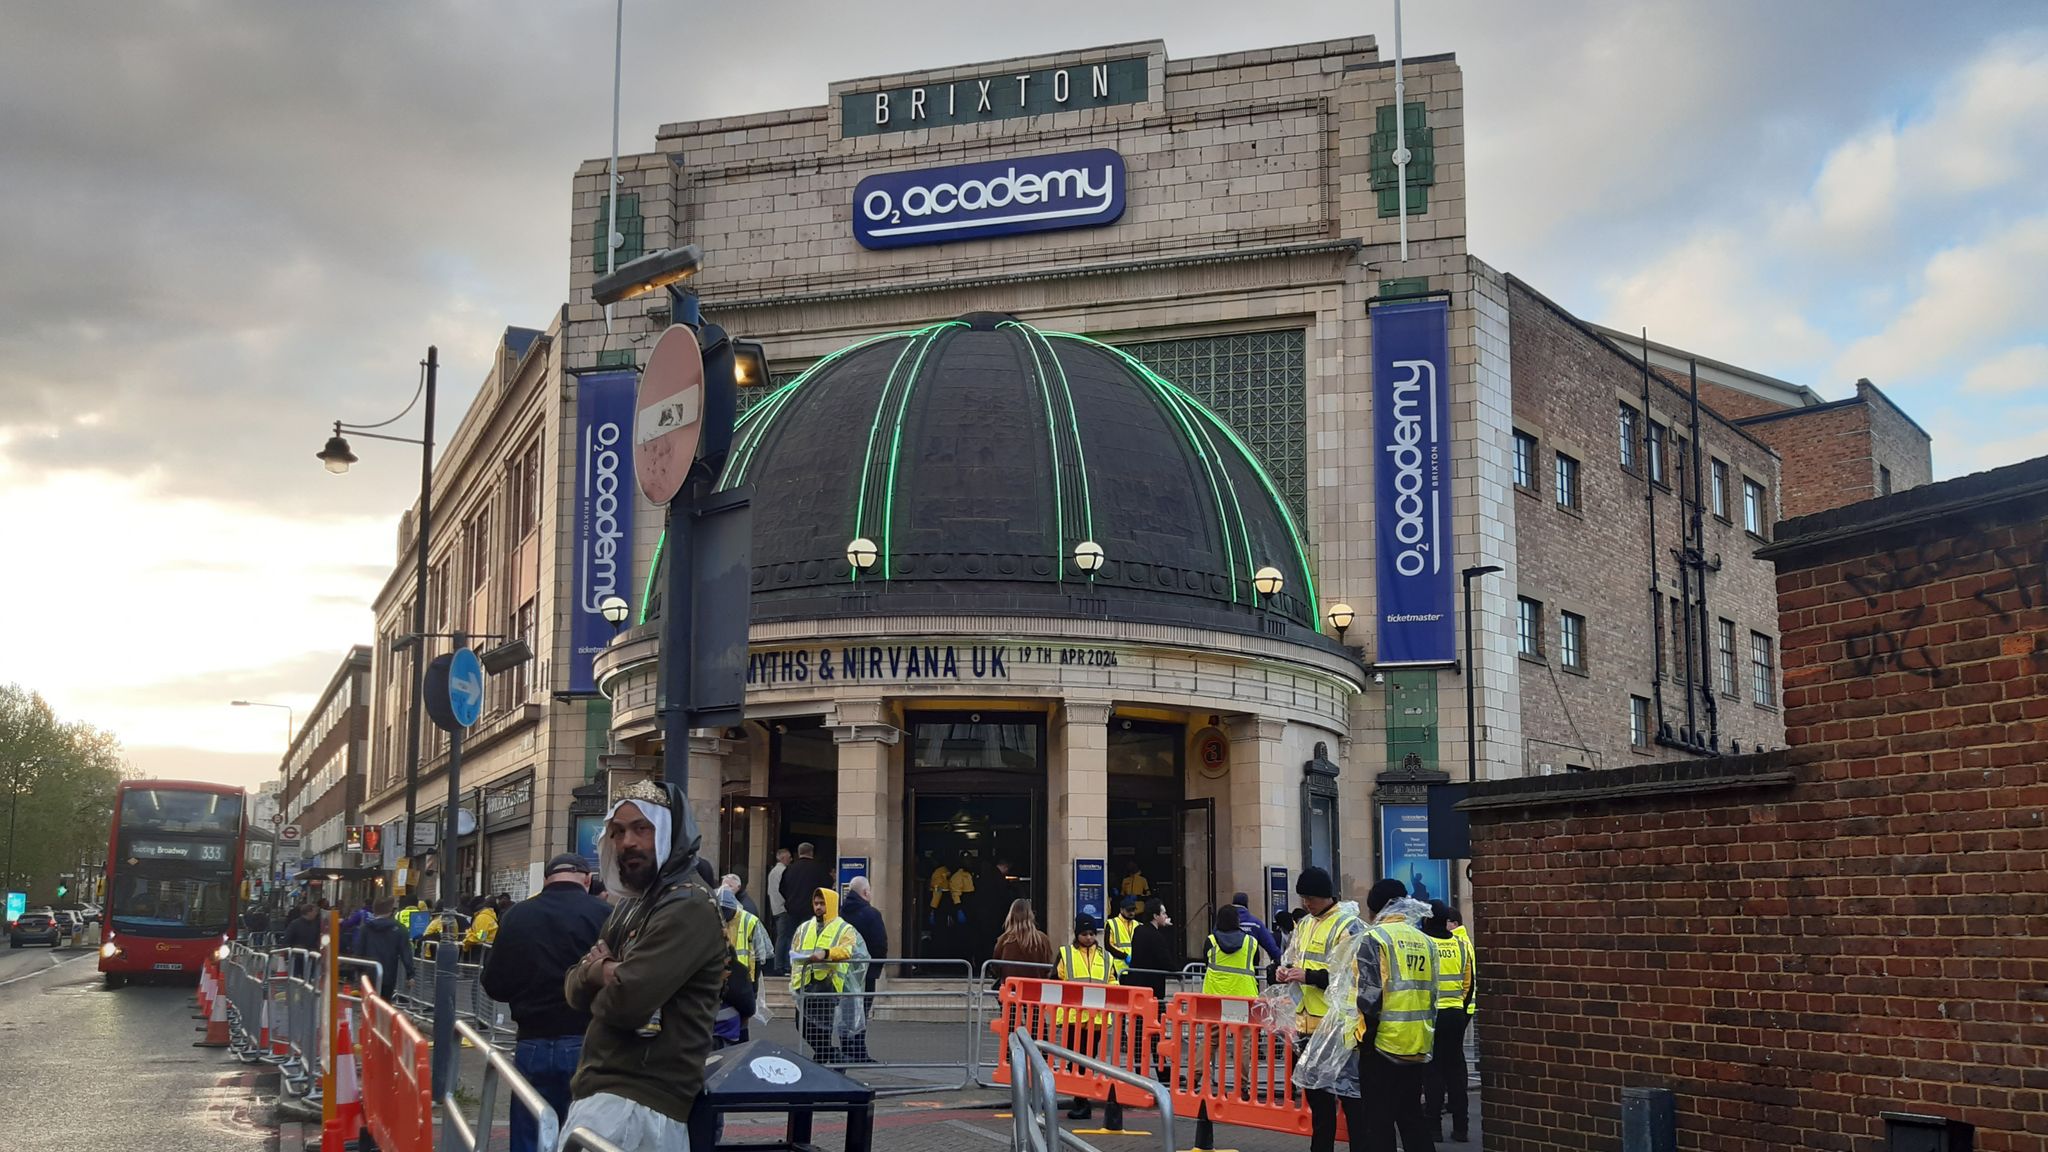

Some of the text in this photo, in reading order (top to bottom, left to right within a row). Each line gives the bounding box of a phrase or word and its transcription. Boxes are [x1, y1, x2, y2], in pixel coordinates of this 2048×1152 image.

[875, 64, 1109, 125] BRIXTON
[902, 165, 1113, 217] academy
[1386, 359, 1437, 545] academy
[1431, 446, 1439, 487] BRIXTON
[1387, 613, 1441, 623] ticketmaster
[818, 649, 834, 680] &
[843, 646, 957, 679] NIRVANA
[972, 646, 1007, 678] UK
[1393, 785, 1428, 794] ACADEM
[157, 846, 189, 856] Broadway
[201, 846, 222, 860] 333
